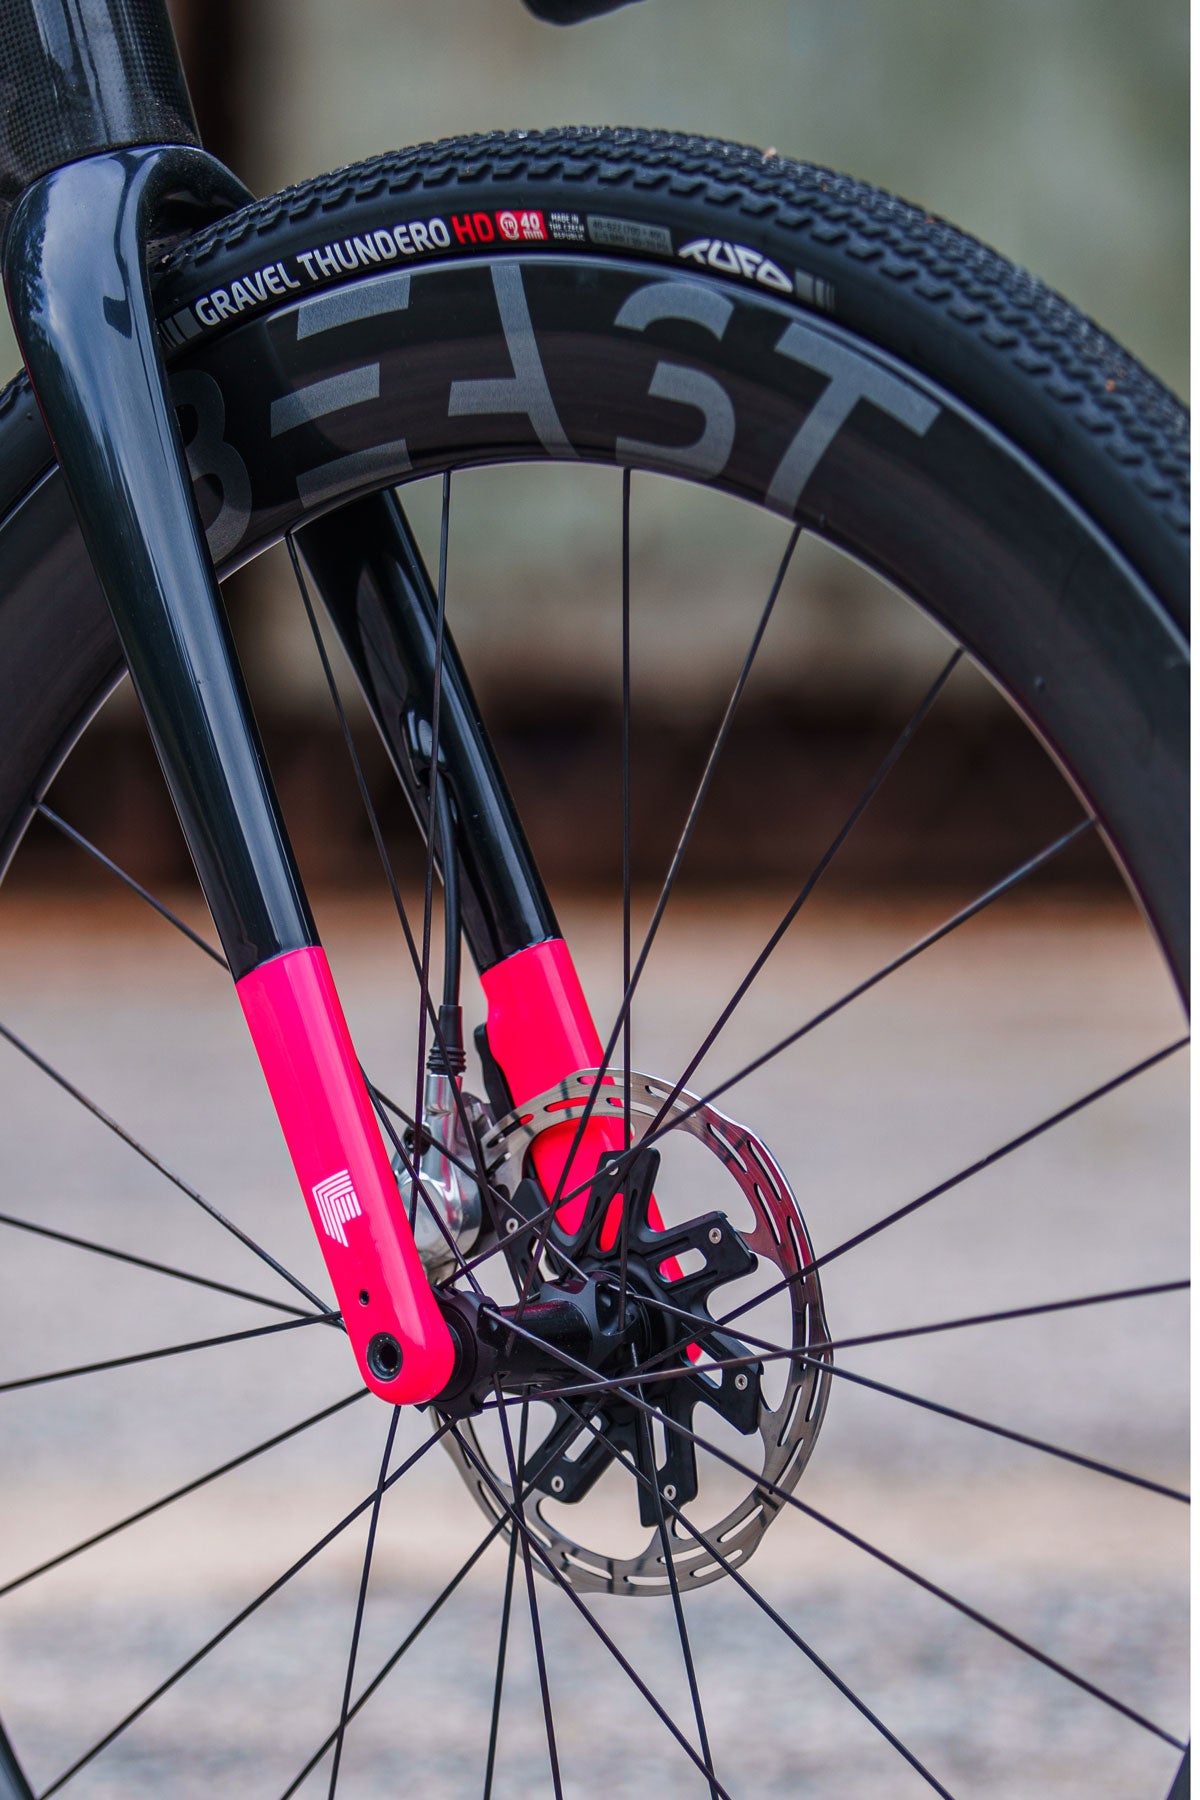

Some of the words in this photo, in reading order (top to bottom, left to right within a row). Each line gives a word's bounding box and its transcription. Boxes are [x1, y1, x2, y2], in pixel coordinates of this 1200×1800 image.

[521, 212, 540, 231] 40
[549, 221, 562, 232] THE
[551, 212, 570, 224] MADE
[571, 214, 579, 225] IN
[523, 230, 544, 240] mm
[553, 231, 586, 242] REPUBLIC
[195, 262, 300, 326] GRAVEL
[296, 217, 451, 281] THUNDERO
[451, 211, 495, 244] HD
[678, 238, 794, 293] TUFO
[167, 265, 942, 566] BEAST
